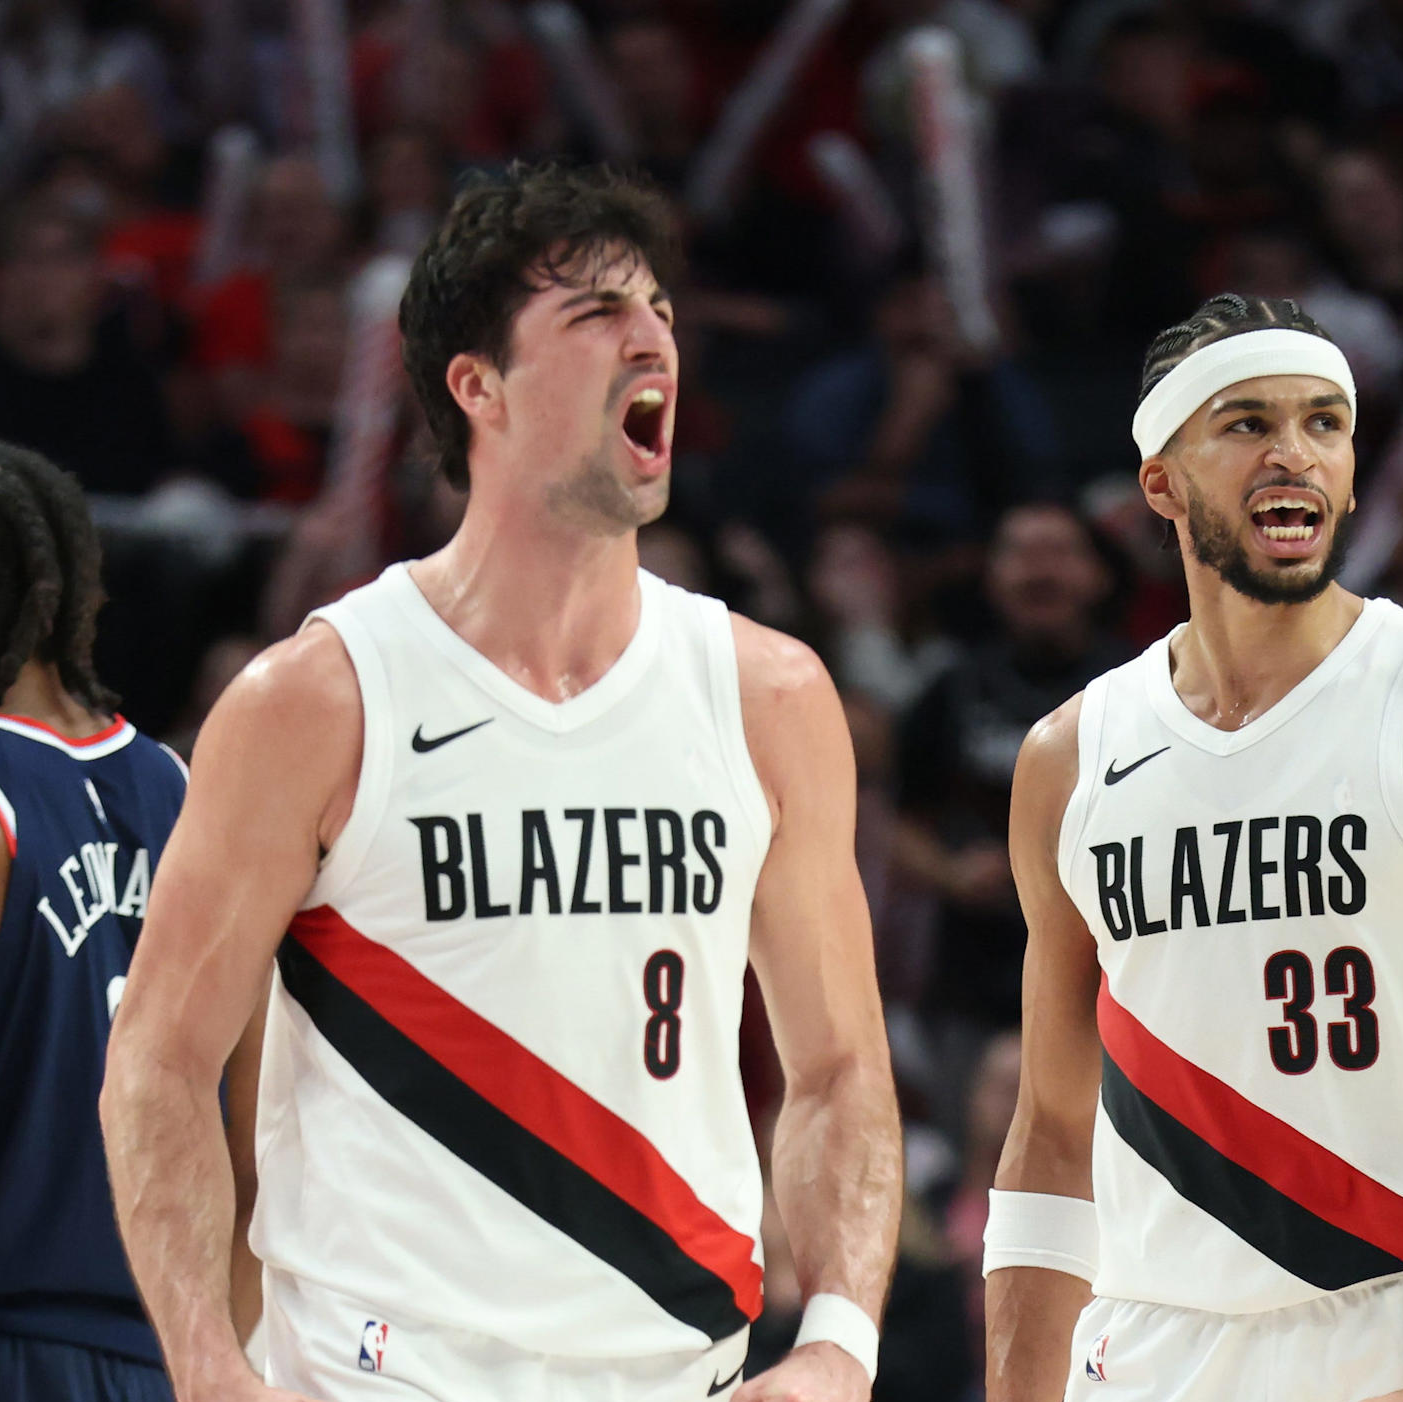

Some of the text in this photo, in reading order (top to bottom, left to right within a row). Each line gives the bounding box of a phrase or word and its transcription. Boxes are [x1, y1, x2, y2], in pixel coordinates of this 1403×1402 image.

[407, 808, 727, 922] BLAZERS
[1088, 813, 1367, 942] BLAZERS
[643, 948, 685, 1081] 8
[1263, 945, 1380, 1076] 33
